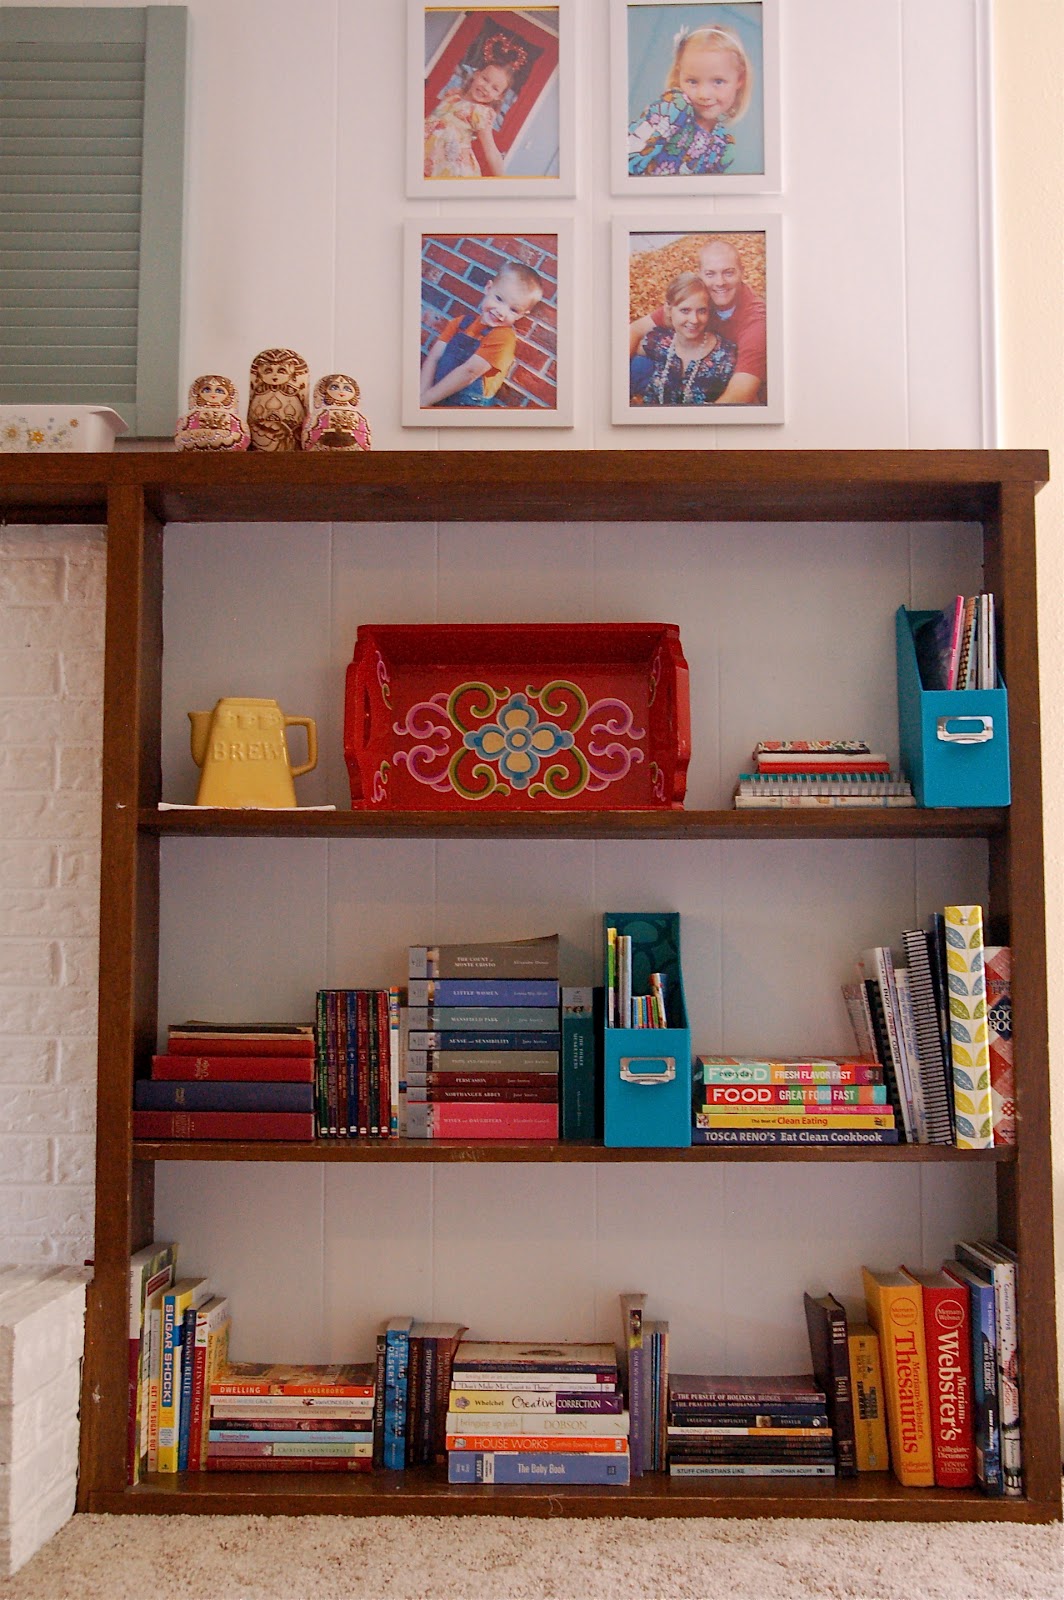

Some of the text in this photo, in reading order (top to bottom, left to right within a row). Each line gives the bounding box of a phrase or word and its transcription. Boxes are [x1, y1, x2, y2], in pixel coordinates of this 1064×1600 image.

[213, 741, 283, 762] BREW
[988, 1010, 1012, 1020] COO
[887, 1011, 895, 1037] CHINESE
[989, 1020, 1012, 1031] BOO
[775, 1071, 852, 1080] FRESH FLAVOR FAST
[713, 1088, 772, 1102] FOOD
[779, 1091, 855, 1100] GREAT FOOD FAST
[802, 1117, 828, 1126] Eating
[705, 1132, 882, 1141] TOSCA RENO'S Eat Clean Cookbook
[164, 1304, 174, 1349] SUGAR
[163, 1353, 172, 1402] SHOCK!
[183, 1366, 192, 1394] RELIEF
[938, 1330, 962, 1441] Webster's
[895, 1331, 919, 1454] Thesaurus
[512, 1396, 600, 1409] Creative CORRECTION
[956, 1376, 966, 1424] Merriam-
[544, 1420, 587, 1430] DOBSON
[474, 1439, 548, 1449] HOUSE WORKS
[518, 1464, 565, 1475] The Baby Book
